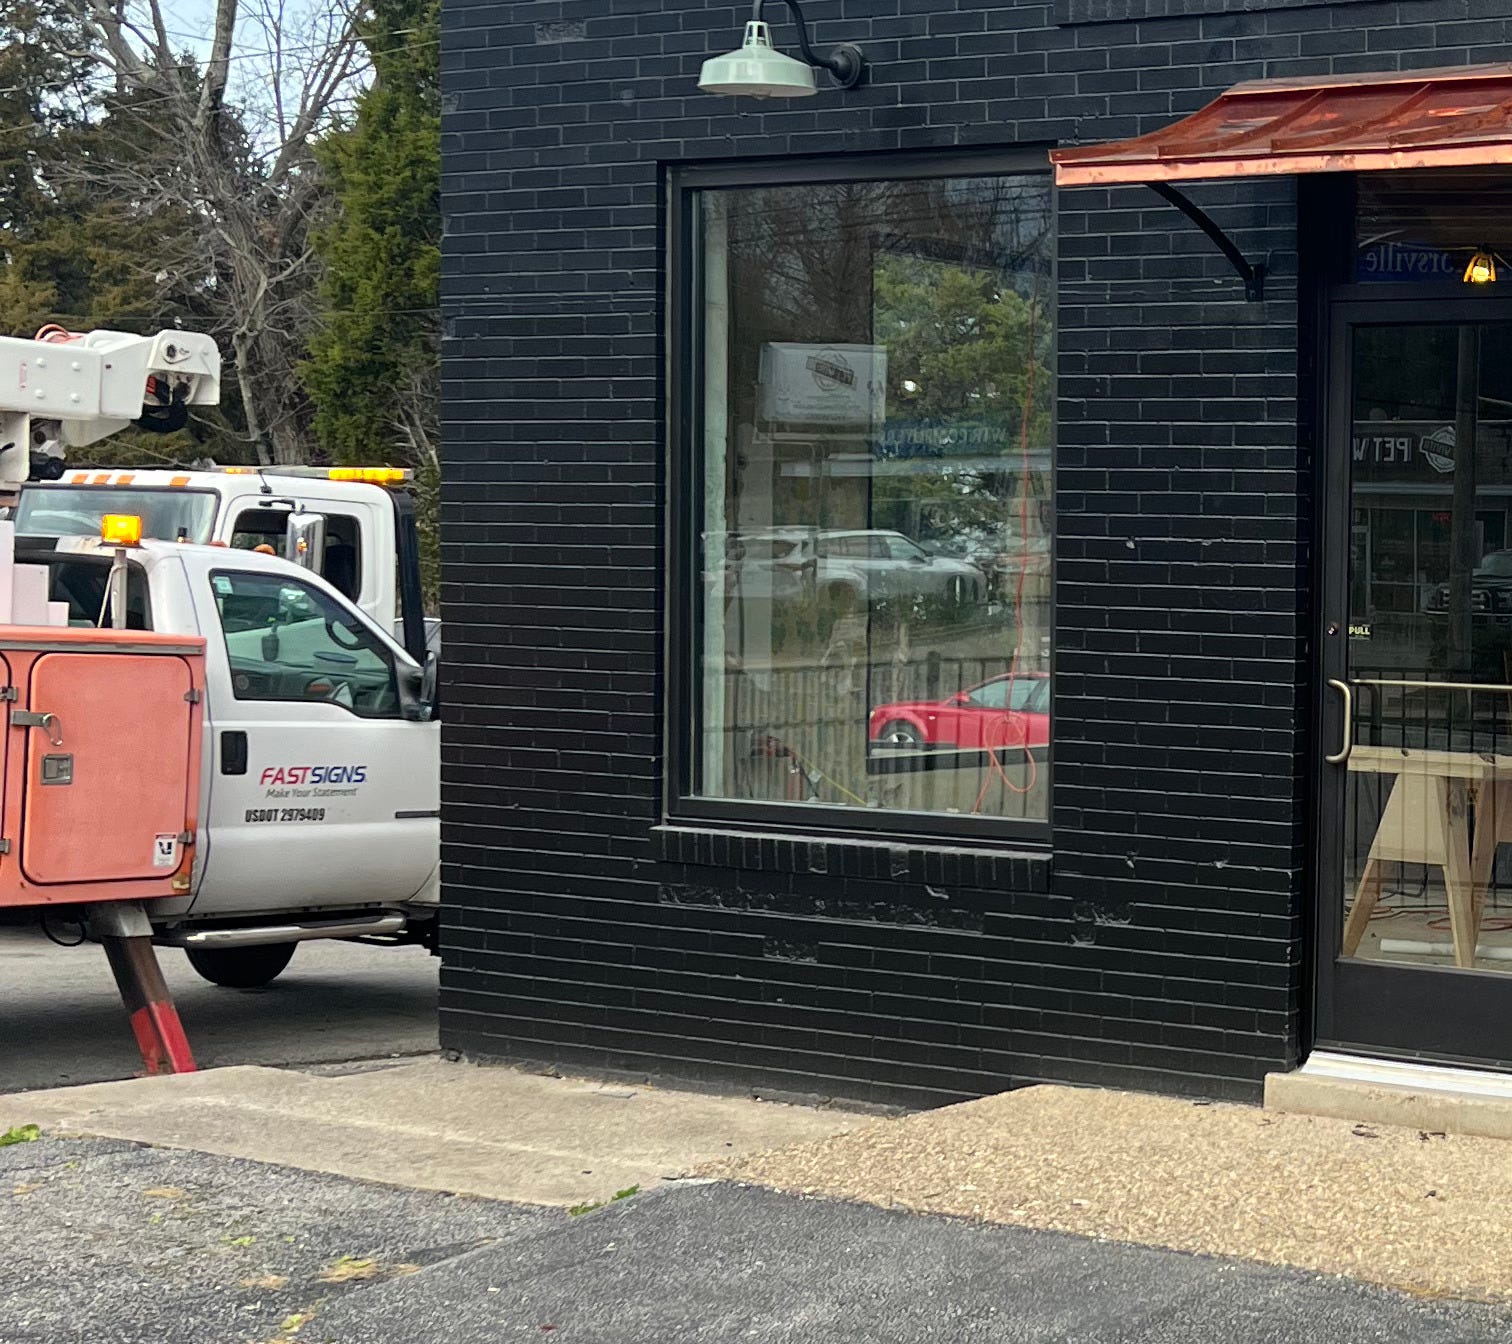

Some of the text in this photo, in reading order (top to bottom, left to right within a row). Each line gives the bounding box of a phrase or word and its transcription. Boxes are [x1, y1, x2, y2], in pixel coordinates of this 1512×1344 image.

[1348, 626, 1371, 635] PULL
[260, 765, 368, 786] FASTSIGNS
[265, 786, 359, 799] Make Your Statement
[245, 808, 279, 823] USDOT
